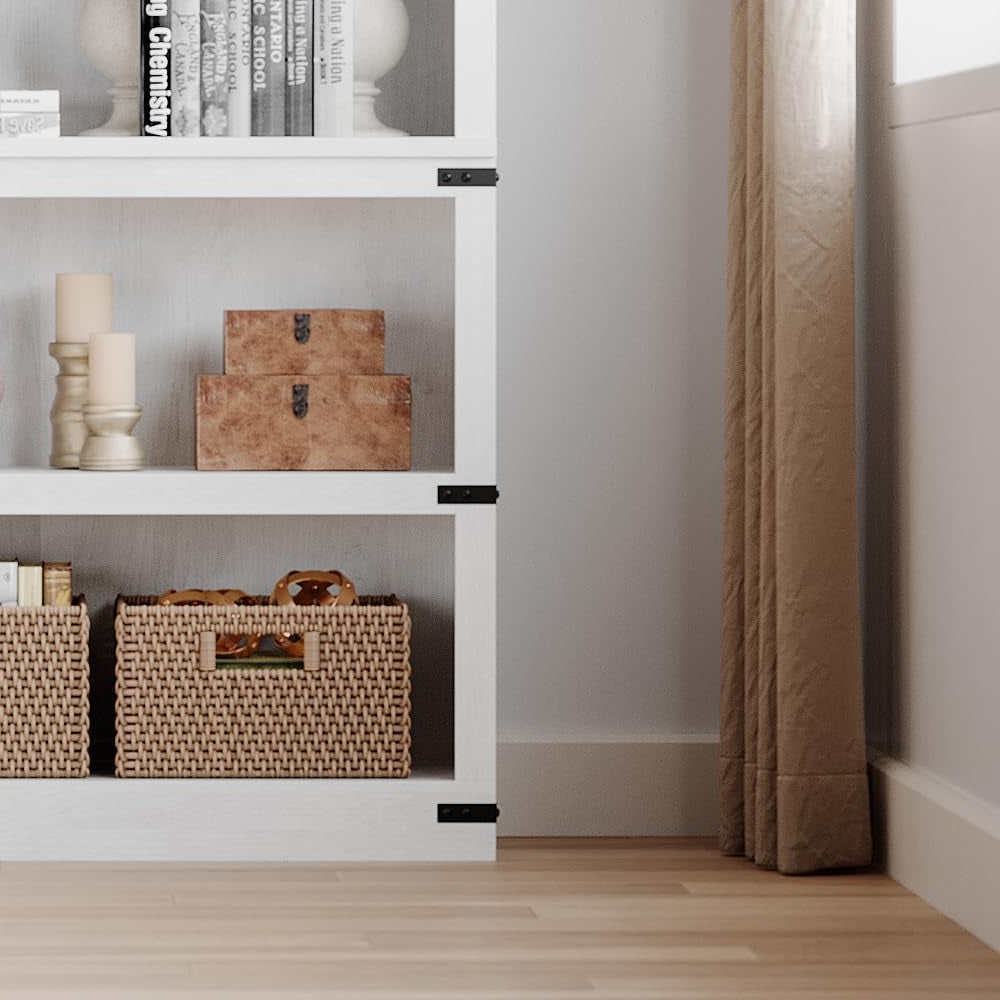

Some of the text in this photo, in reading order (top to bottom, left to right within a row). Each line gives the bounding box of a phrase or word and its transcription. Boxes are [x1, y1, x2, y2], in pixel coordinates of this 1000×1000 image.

[201, 11, 227, 74] ENGLAND
[253, 25, 266, 92] SCHOOL
[295, 26, 305, 35] a
[331, 38, 345, 84] Nation
[145, 26, 171, 136] Chemistry
[228, 32, 237, 93] SCHOOL
[295, 38, 309, 86] Nation
